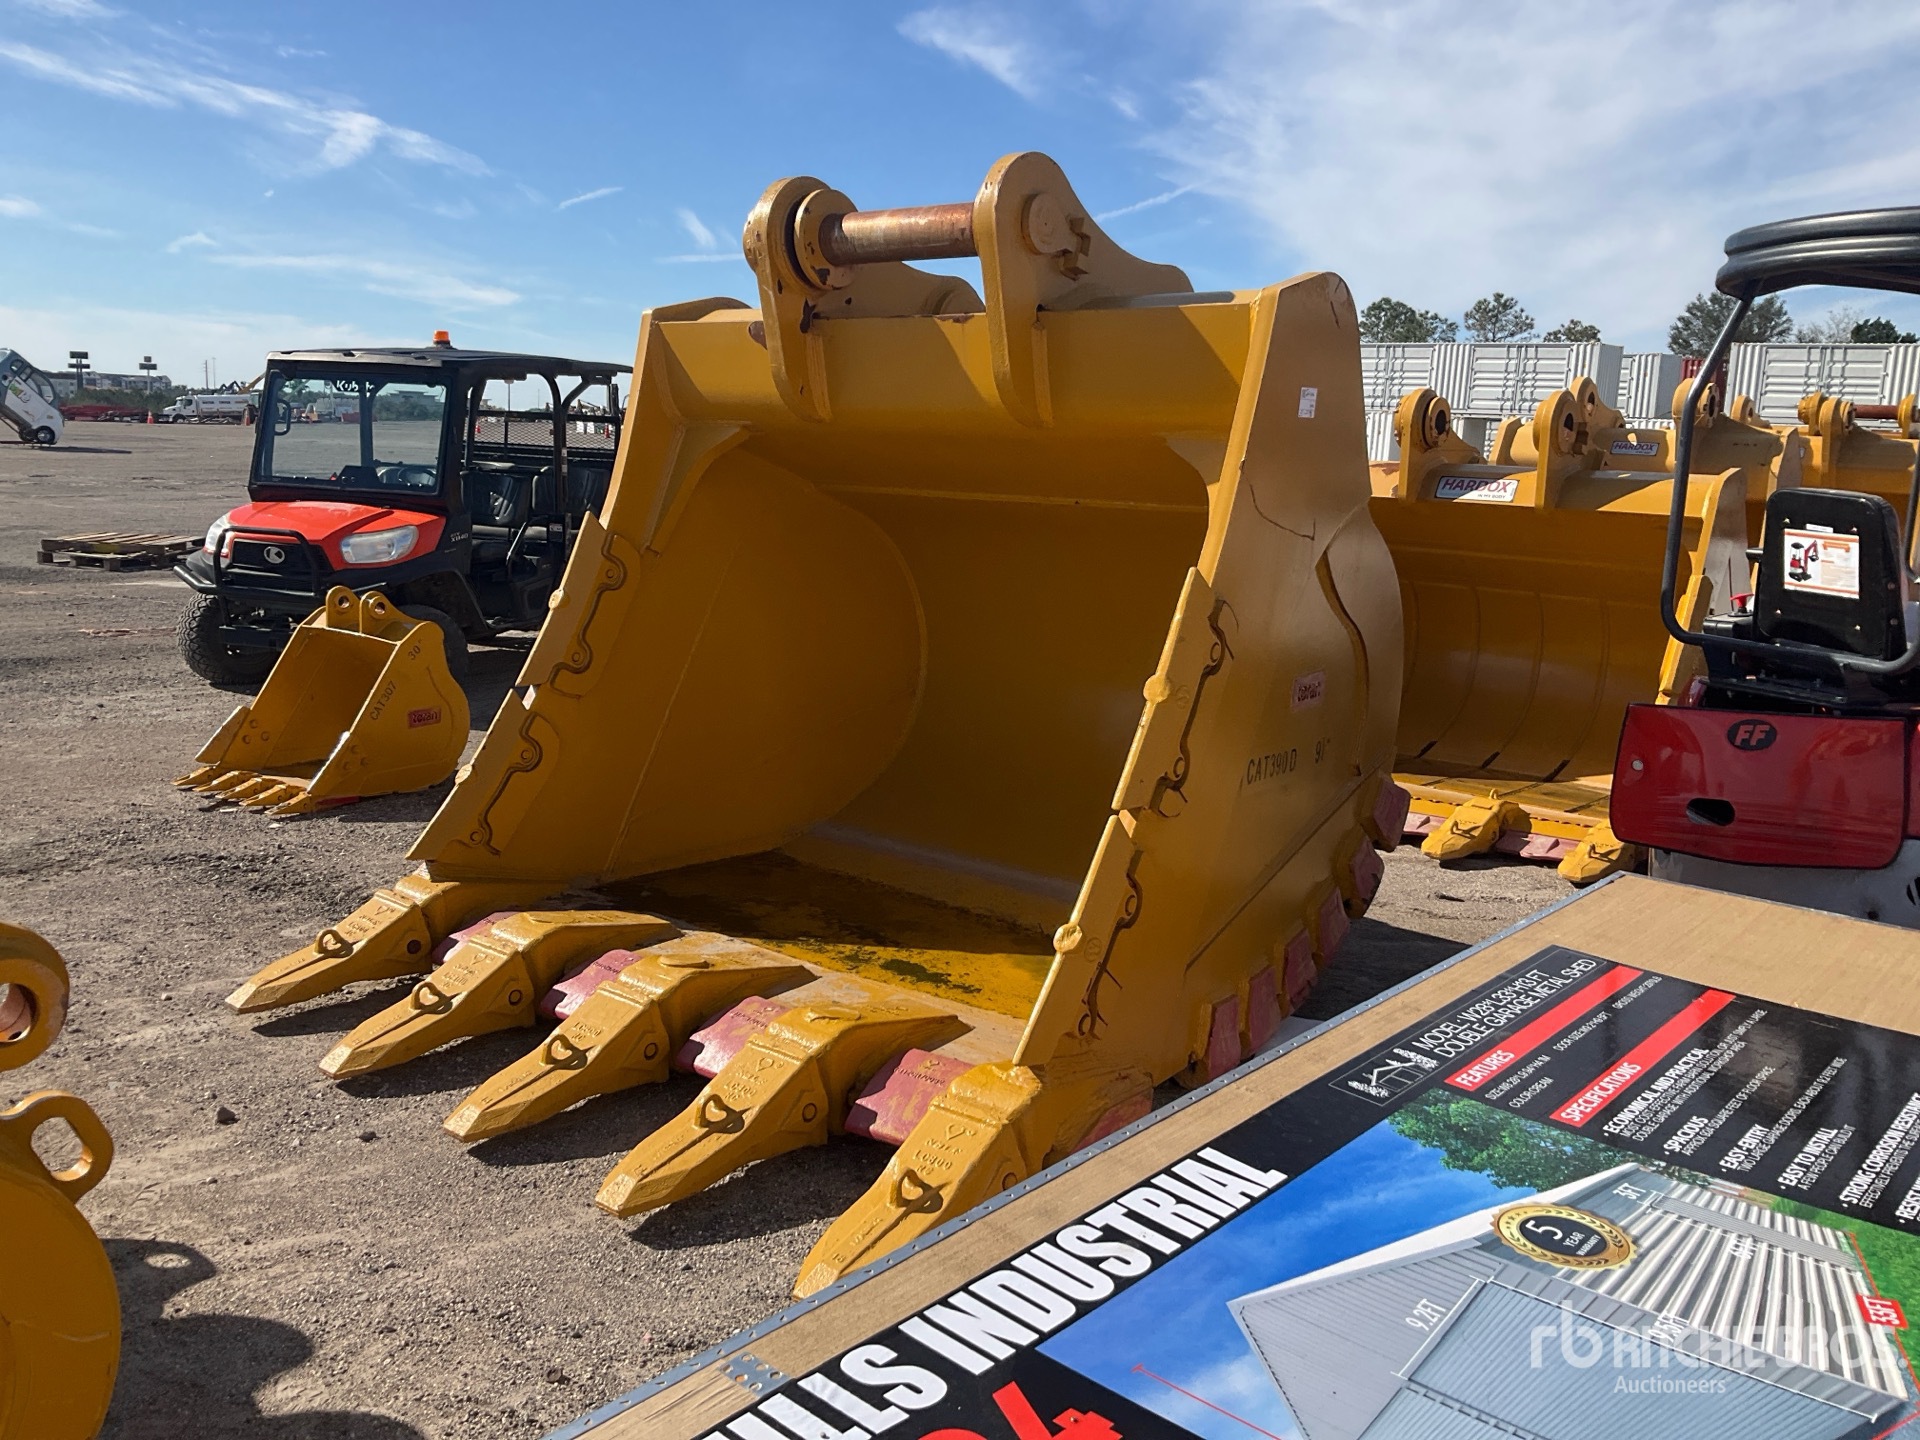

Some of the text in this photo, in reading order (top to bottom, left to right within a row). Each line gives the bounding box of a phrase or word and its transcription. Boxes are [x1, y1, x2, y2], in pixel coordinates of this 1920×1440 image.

[1614, 442, 1656, 451] HARDOX
[1441, 478, 1514, 493] HARDOX
[370, 680, 397, 721] CAT307
[1734, 725, 1771, 746] FF
[1524, 969, 1552, 980] FT
[1432, 958, 1598, 1057] DOUBLE GARAGE METAL SHED
[1453, 1049, 1517, 1086] FEATURES
[1558, 1061, 1643, 1121] SPECIFICATIONS
[1602, 1046, 1709, 1133] ECONOMICAL AND PRACTICAL
[1632, 1040, 1747, 1141] DOUBLE GARAGE WITH ADDITIONAL WORKSHOP AREA
[1734, 1091, 1750, 1100] OF
[1740, 1077, 1764, 1094] FLOOR
[1724, 1097, 1744, 1110] FEET
[1620, 1122, 1641, 1136] MOST
[1706, 1107, 1734, 1129] SQUARE
[1737, 1158, 1757, 1172] TWO
[1748, 1142, 1771, 1160] LARGE
[1762, 1123, 1787, 1145] GARAGE
[1794, 1094, 1814, 1108] EACH
[1804, 1081, 1825, 1097] ABOUT
[1661, 1115, 1709, 1152] SPACIOUS
[1832, 1128, 1853, 1144] BUILD
[1679, 1134, 1708, 1156] APPROX
[1719, 1123, 1771, 1169] EASY-ENTRY
[1777, 1125, 1838, 1186] EASY TO INSTALL
[1824, 1141, 1843, 1155] CAN
[1809, 1152, 1834, 1174] PEOPLE
[1838, 1168, 1876, 1204] STRONG
[1860, 1127, 1905, 1173] CORROSION
[1859, 1173, 1891, 1208] EFFECTIVELY
[1882, 1147, 1909, 1176] PREVENTS
[1899, 1138, 1916, 1150] THE
[1797, 1182, 1810, 1190] A
[1800, 1171, 1819, 1185] FEW
[1612, 1182, 1647, 1200] 3FT
[1525, 1219, 1563, 1240] 5
[1562, 1231, 1586, 1247] YEAR
[1576, 1234, 1602, 1256] WARRANTY
[898, 1147, 1288, 1376] INDUSTRIAL
[1405, 1299, 1447, 1332] 9.2FT
[1862, 1295, 1900, 1326] 33FT
